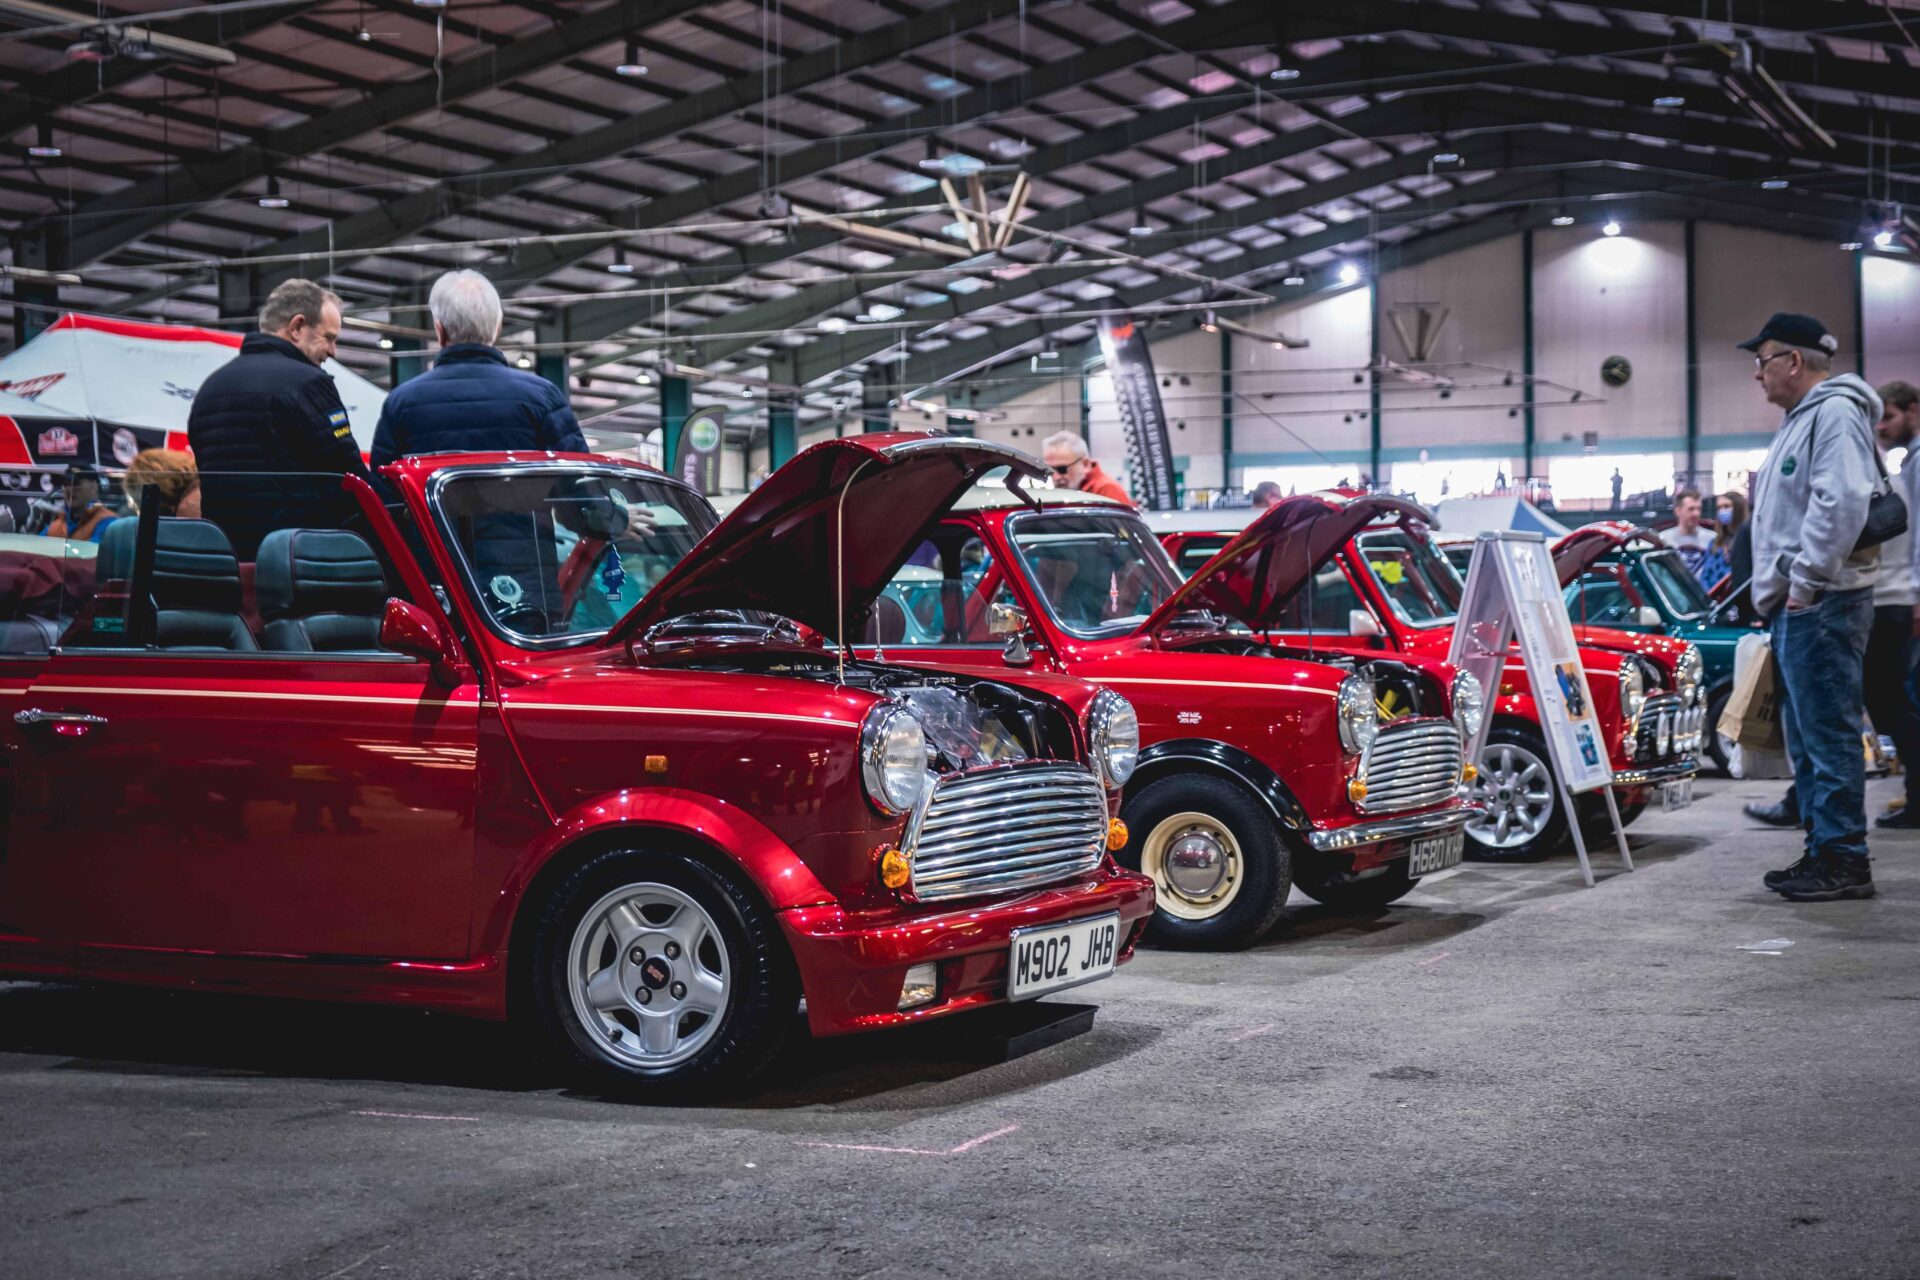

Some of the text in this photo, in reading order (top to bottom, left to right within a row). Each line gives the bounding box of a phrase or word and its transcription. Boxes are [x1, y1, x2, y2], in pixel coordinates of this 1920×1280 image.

[1412, 839, 1445, 874] H680
[1016, 924, 1115, 986] M902 JHB
